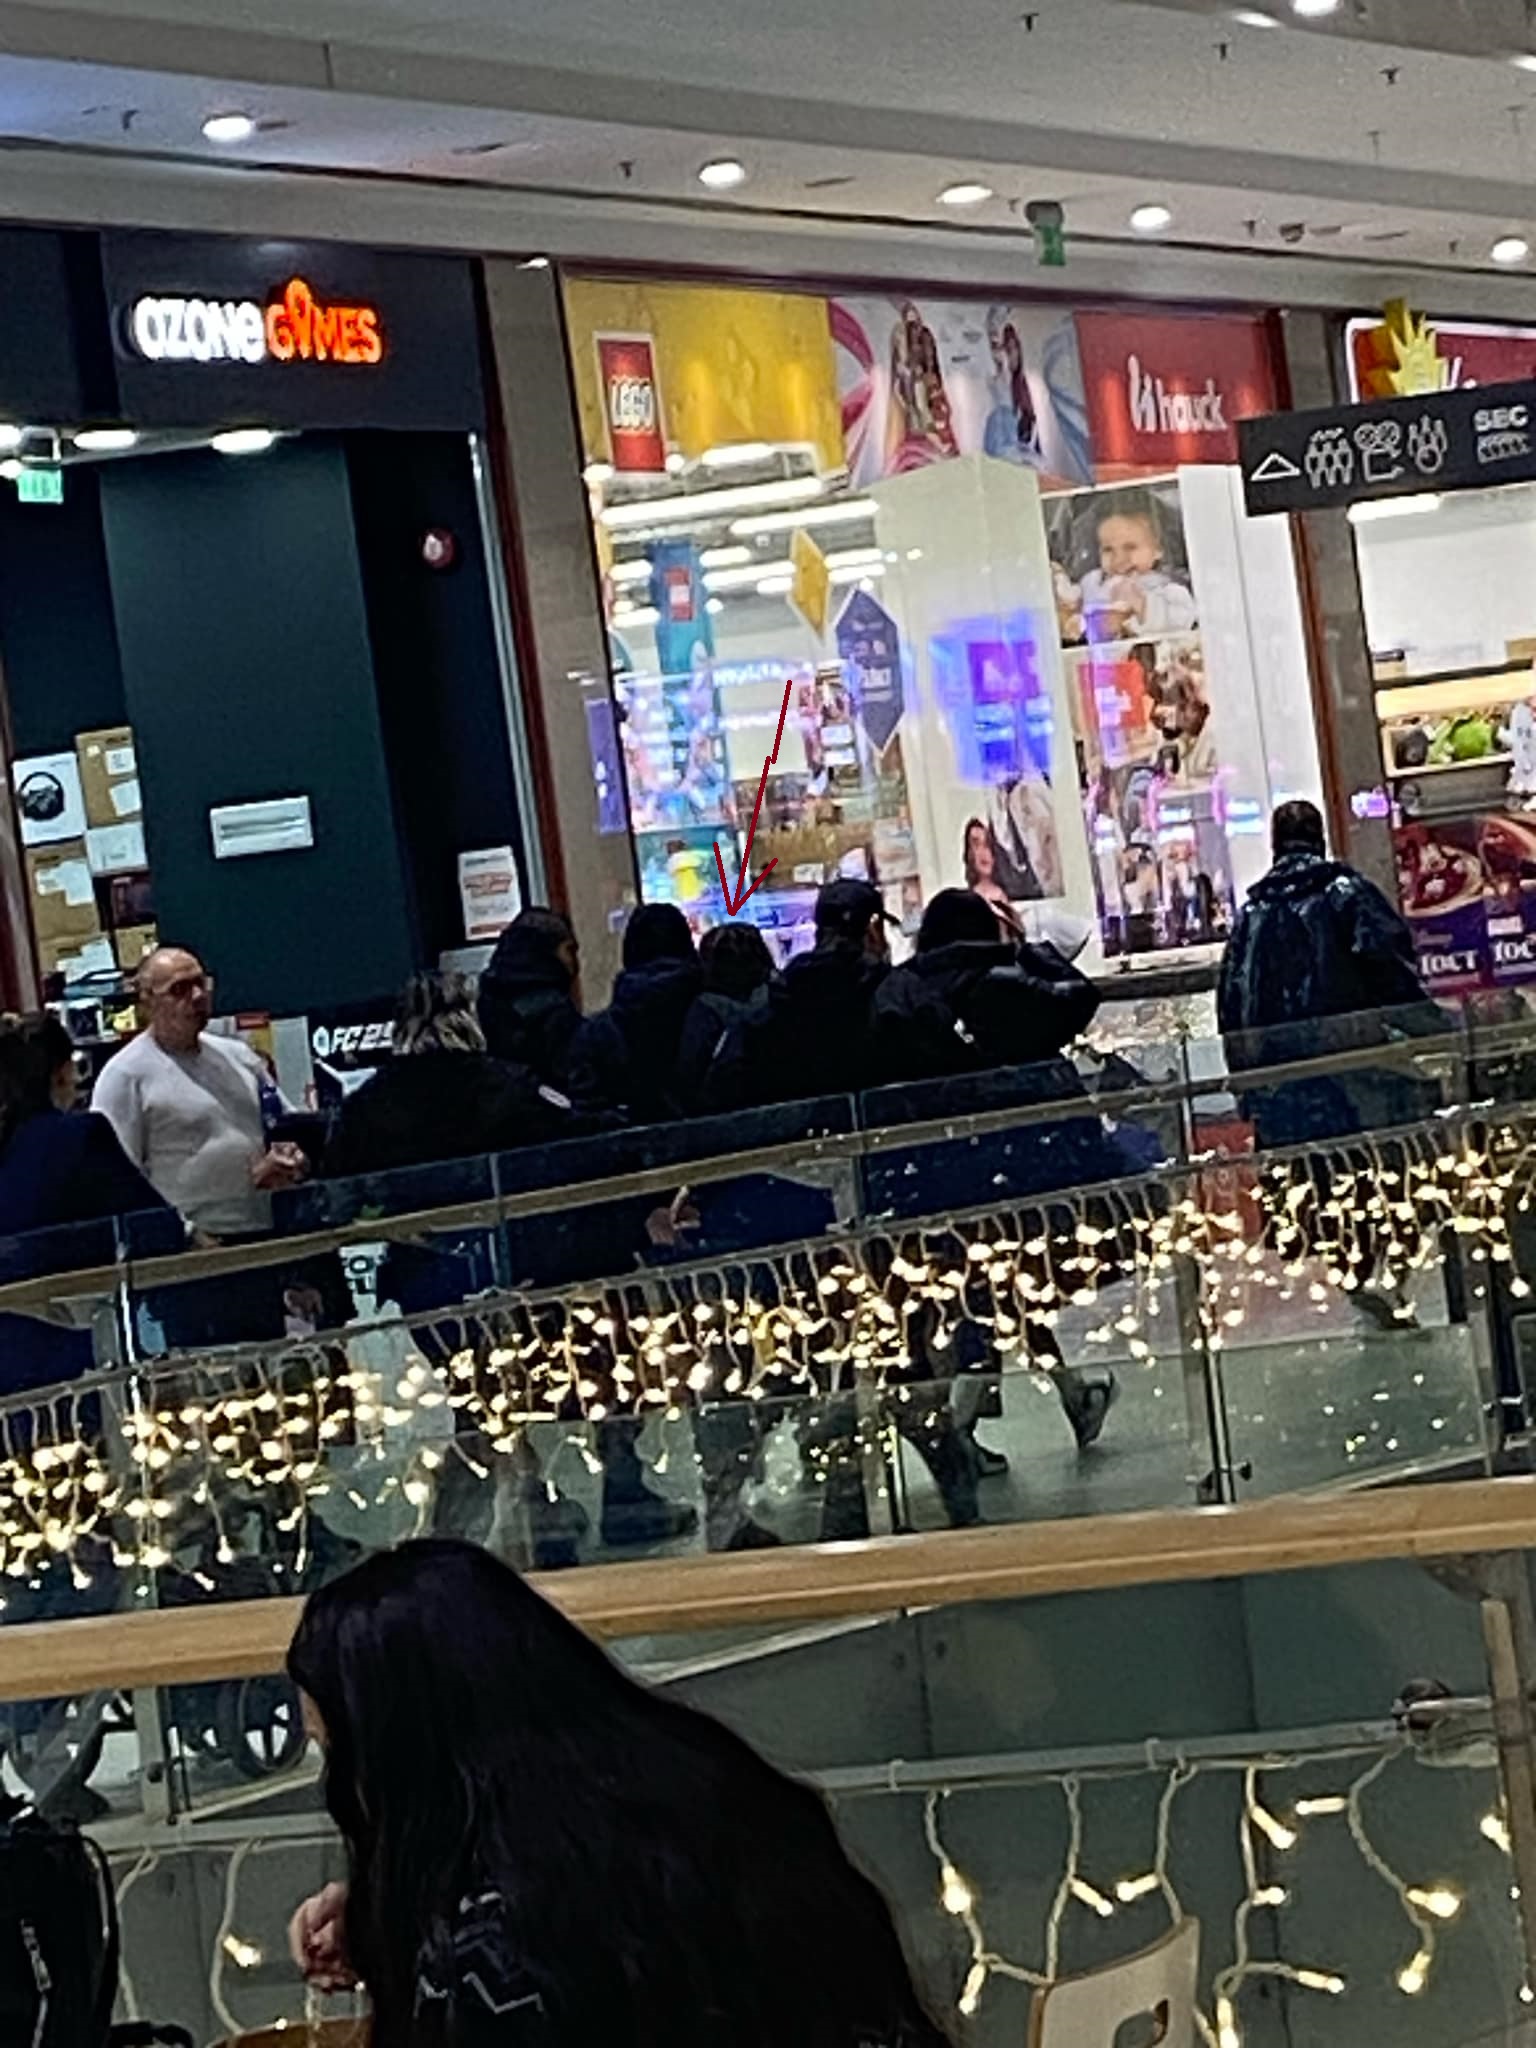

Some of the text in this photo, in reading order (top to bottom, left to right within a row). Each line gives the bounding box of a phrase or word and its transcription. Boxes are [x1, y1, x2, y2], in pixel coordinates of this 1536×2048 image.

[611, 382, 653, 428] LEGO
[1155, 377, 1228, 434] hauck
[1474, 404, 1529, 432] SEC
